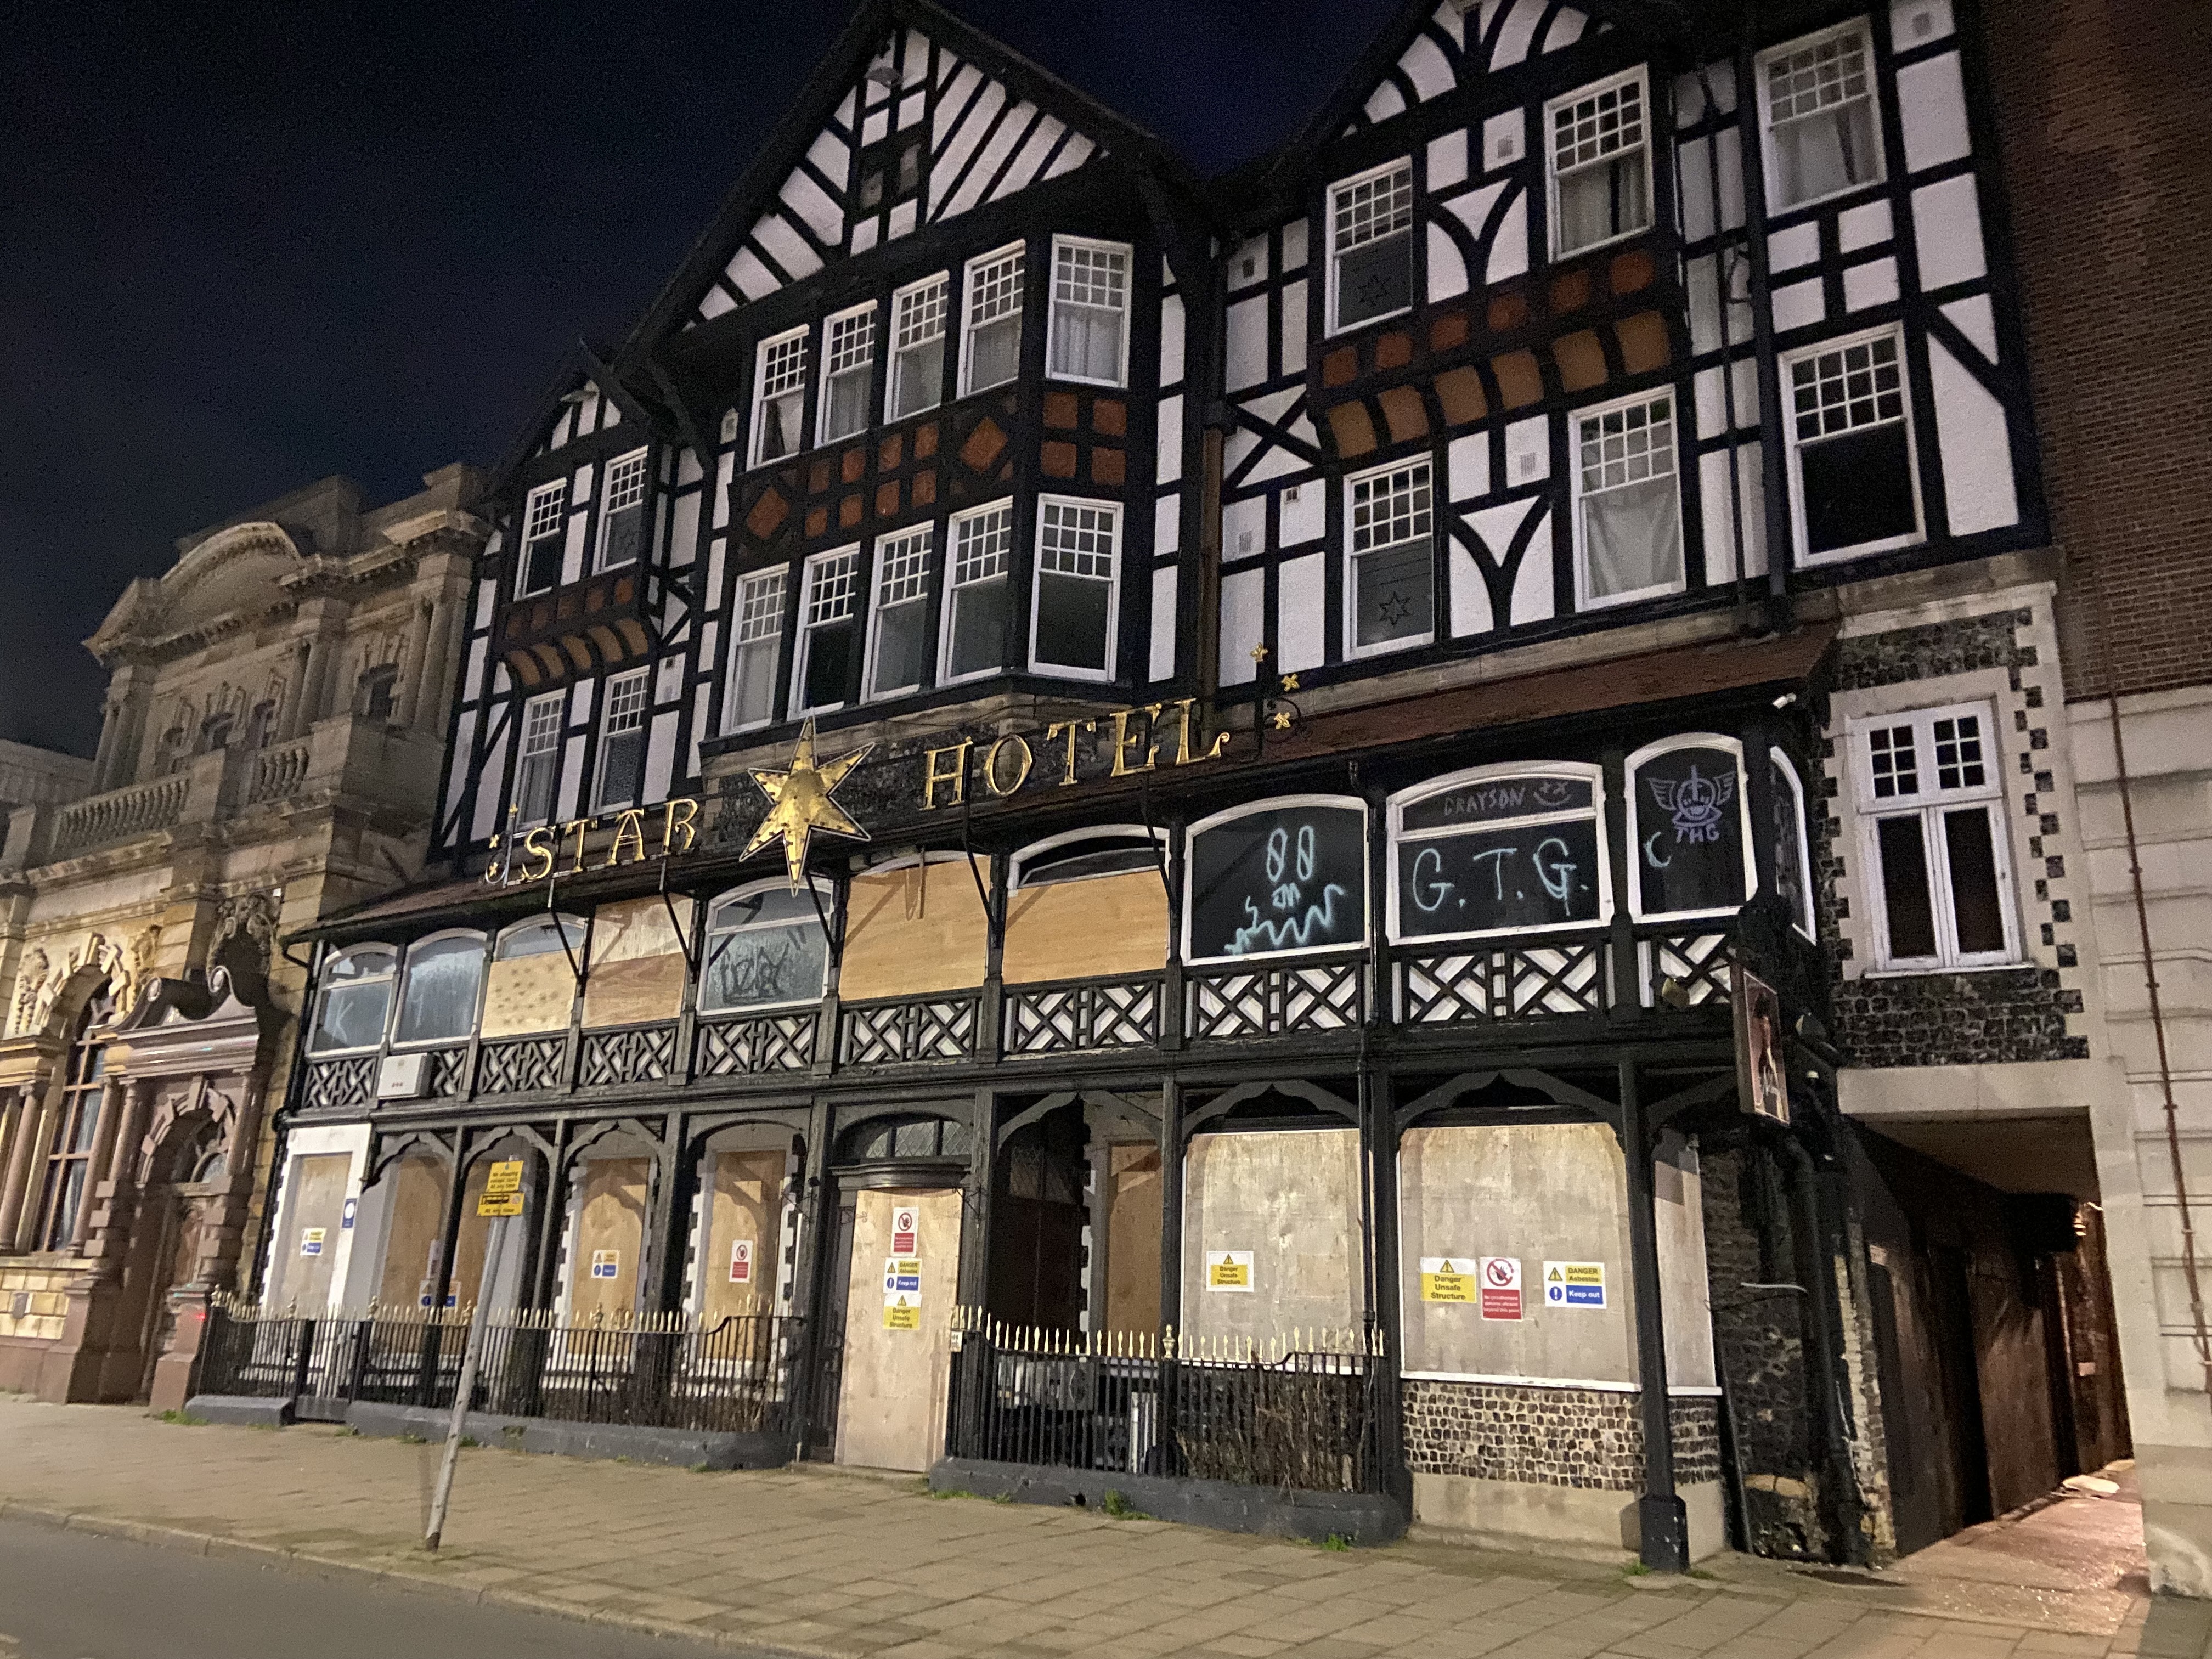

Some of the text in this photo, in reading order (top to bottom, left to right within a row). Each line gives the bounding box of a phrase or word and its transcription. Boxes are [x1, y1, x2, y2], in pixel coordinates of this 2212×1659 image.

[521, 698, 1230, 881] STAR HOTEL
[1434, 1275, 1462, 1283] Danger
[1569, 1290, 1587, 1299] Keep
